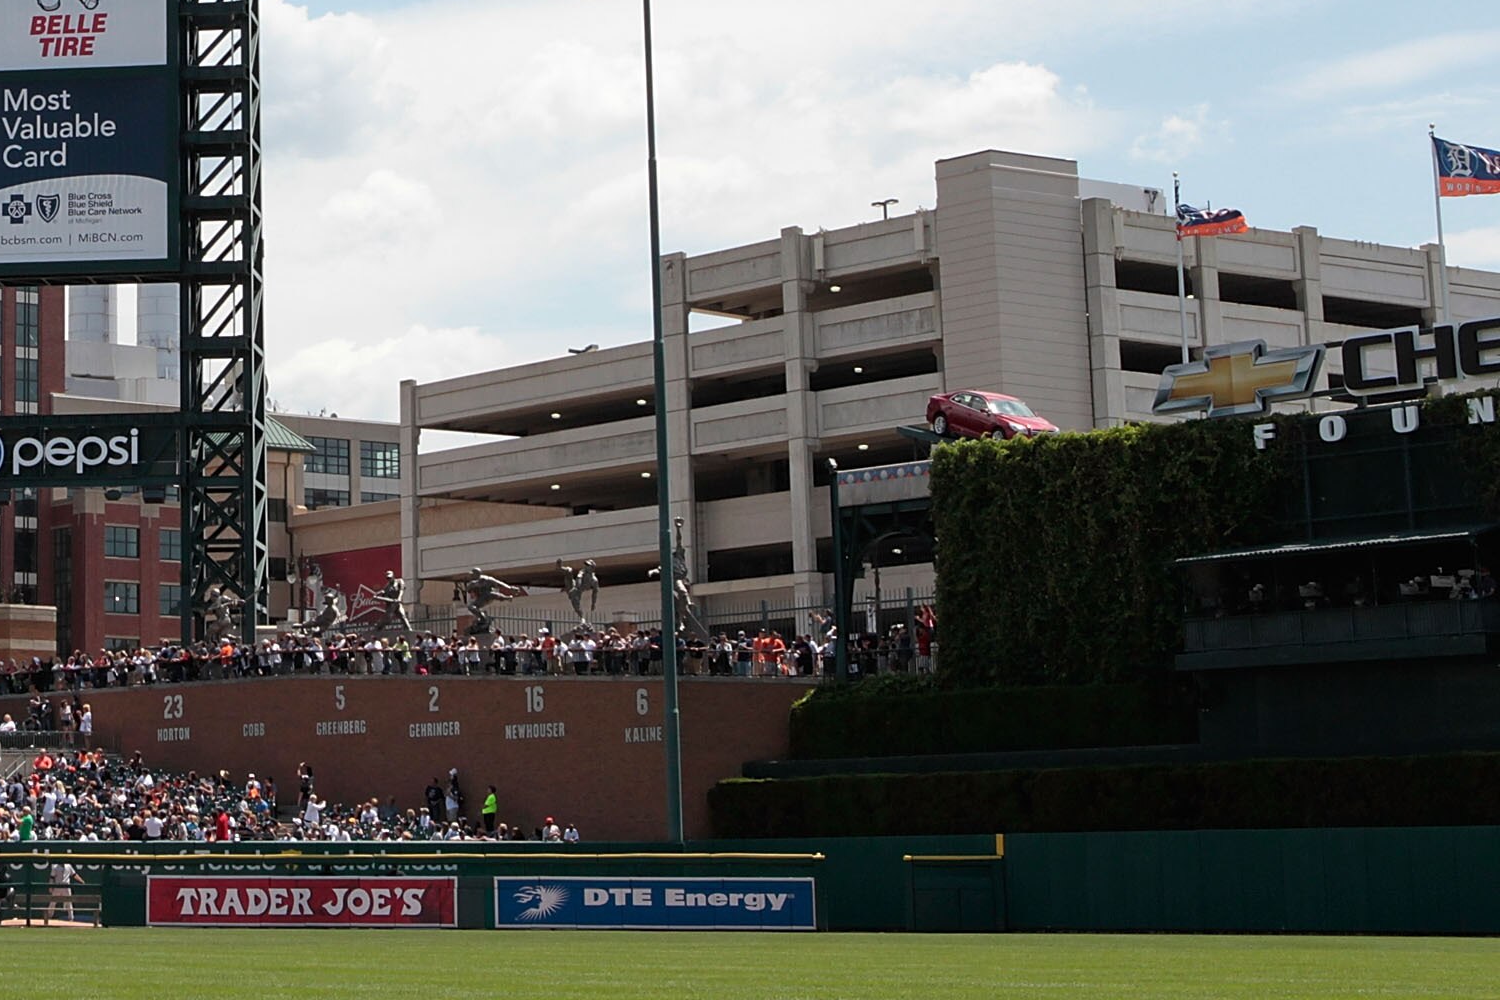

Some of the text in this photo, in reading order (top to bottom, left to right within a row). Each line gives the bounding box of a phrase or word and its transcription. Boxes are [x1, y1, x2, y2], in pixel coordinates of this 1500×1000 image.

[30, 13, 108, 35] BELLE
[39, 36, 95, 57] TIRE
[3, 88, 71, 112] Most
[2, 113, 116, 139] Valuable
[3, 142, 67, 168] Card
[88, 208, 106, 216] Care
[0, 233, 143, 246] bcbsm.com MiBCN.com
[13, 428, 139, 475] pepsi
[164, 694, 184, 719] 23
[335, 685, 346, 710] 5
[428, 686, 439, 711] 2
[525, 686, 544, 712] 16
[636, 688, 649, 715] 6
[157, 727, 191, 742] HORTON
[243, 722, 265, 737] COBB
[316, 720, 367, 736] GREENBERG
[409, 721, 461, 738] GEHRINGER
[505, 722, 565, 739] NEWHOUSER
[625, 726, 662, 743] KALINE
[176, 887, 426, 916] TRADER JOE'S
[584, 888, 788, 911] DTE Energy
